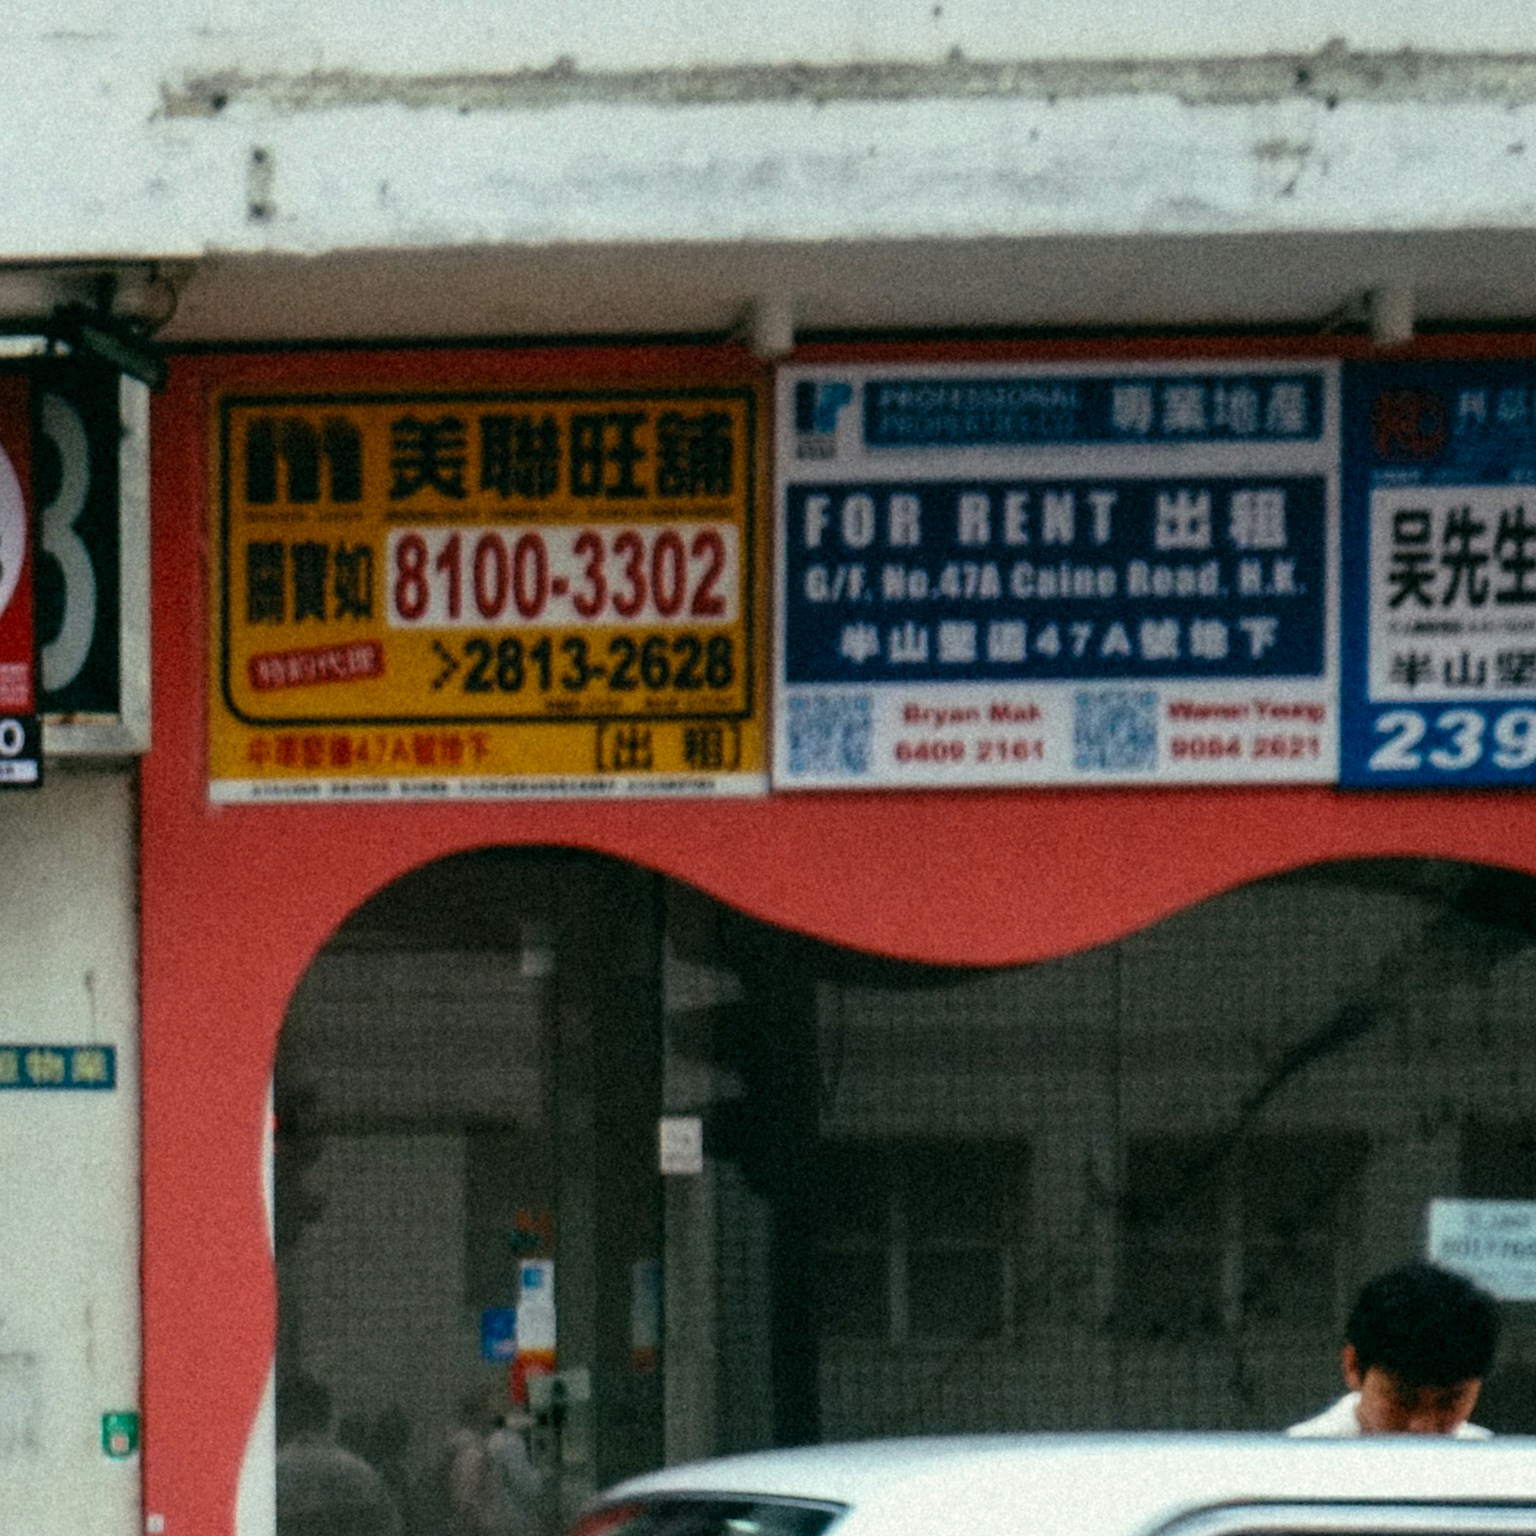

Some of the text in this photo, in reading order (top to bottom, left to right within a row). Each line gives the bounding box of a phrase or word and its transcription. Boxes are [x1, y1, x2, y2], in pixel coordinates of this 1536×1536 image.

[803, 486, 1287, 550] FOR RENT 出租
[394, 529, 727, 622] 8100-3302
[1010, 560, 1117, 598] Caine
[462, 635, 735, 695] 2813-2628
[902, 701, 980, 729] Bryan
